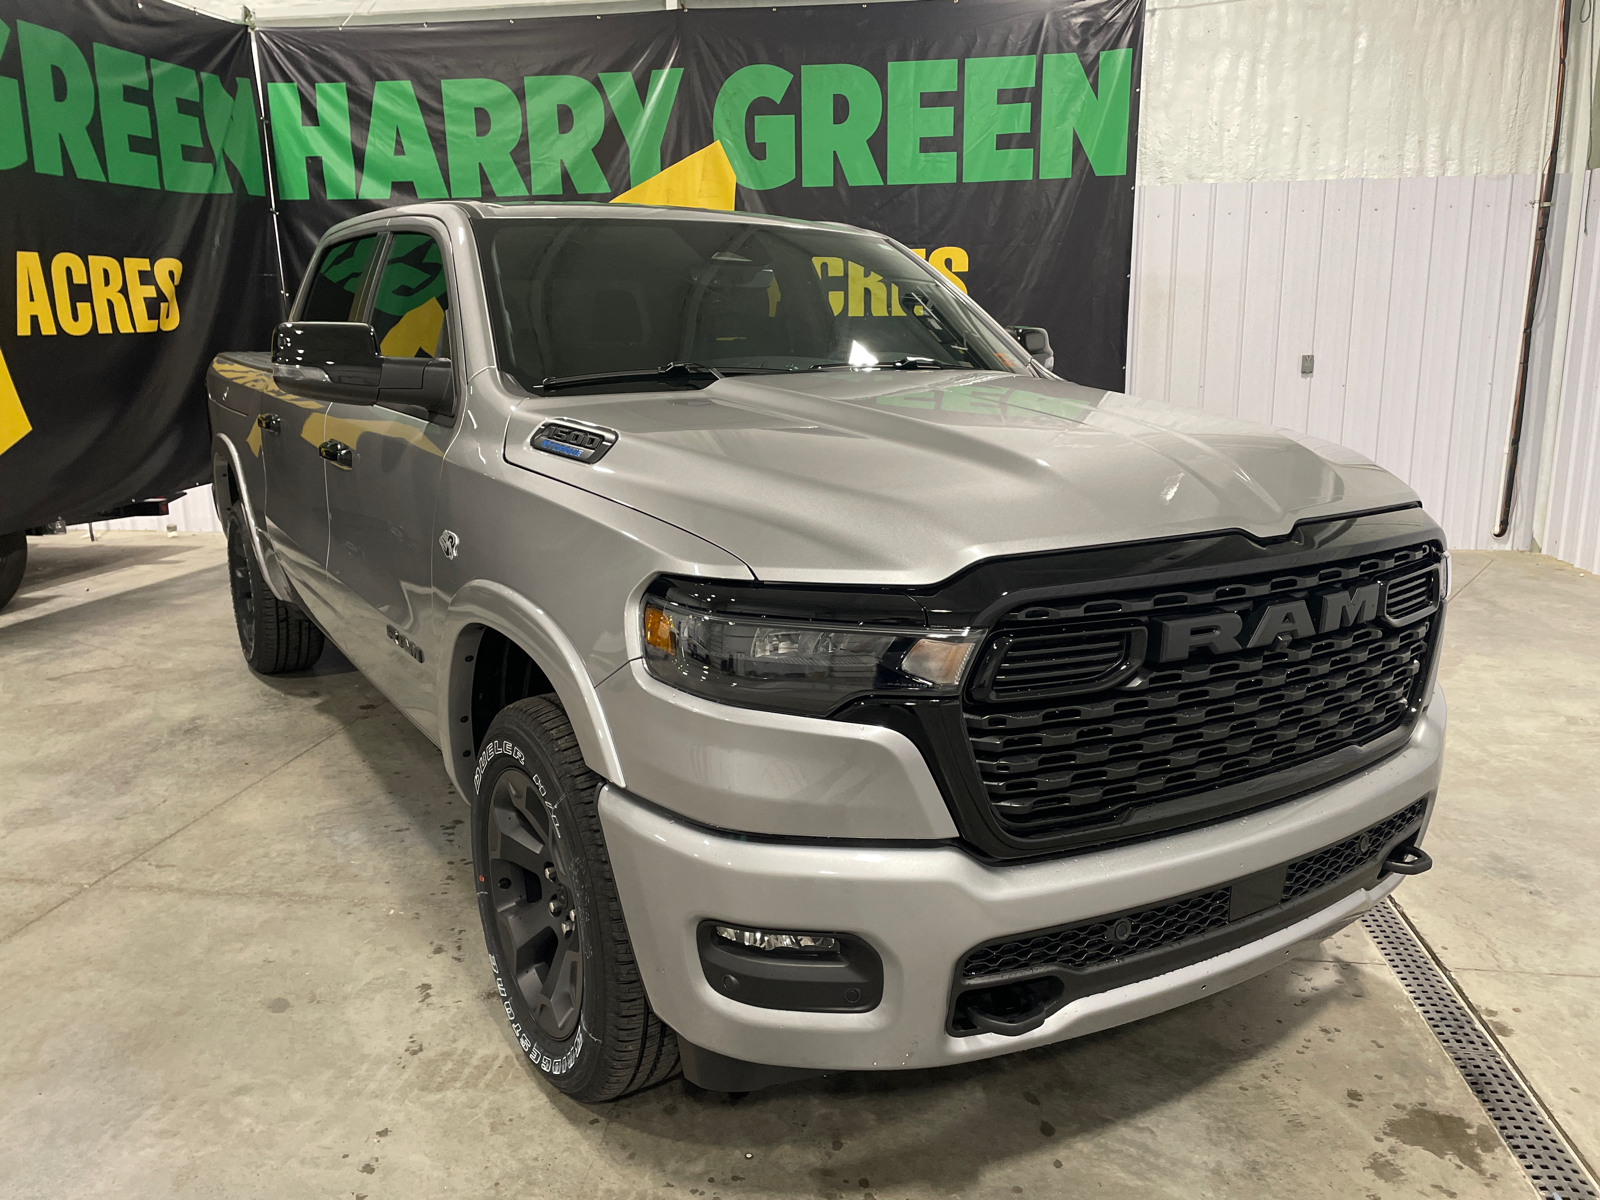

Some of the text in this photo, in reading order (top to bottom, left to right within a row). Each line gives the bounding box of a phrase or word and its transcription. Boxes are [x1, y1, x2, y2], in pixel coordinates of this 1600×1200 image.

[267, 48, 1133, 200] HARRY GREEN
[16, 250, 183, 337] ACRES
[542, 426, 601, 450] 1500
[386, 623, 425, 664] RAM
[1159, 583, 1380, 662] RAM
[473, 740, 525, 796] DUELER
[488, 953, 583, 1075] BRIDGESTONE
